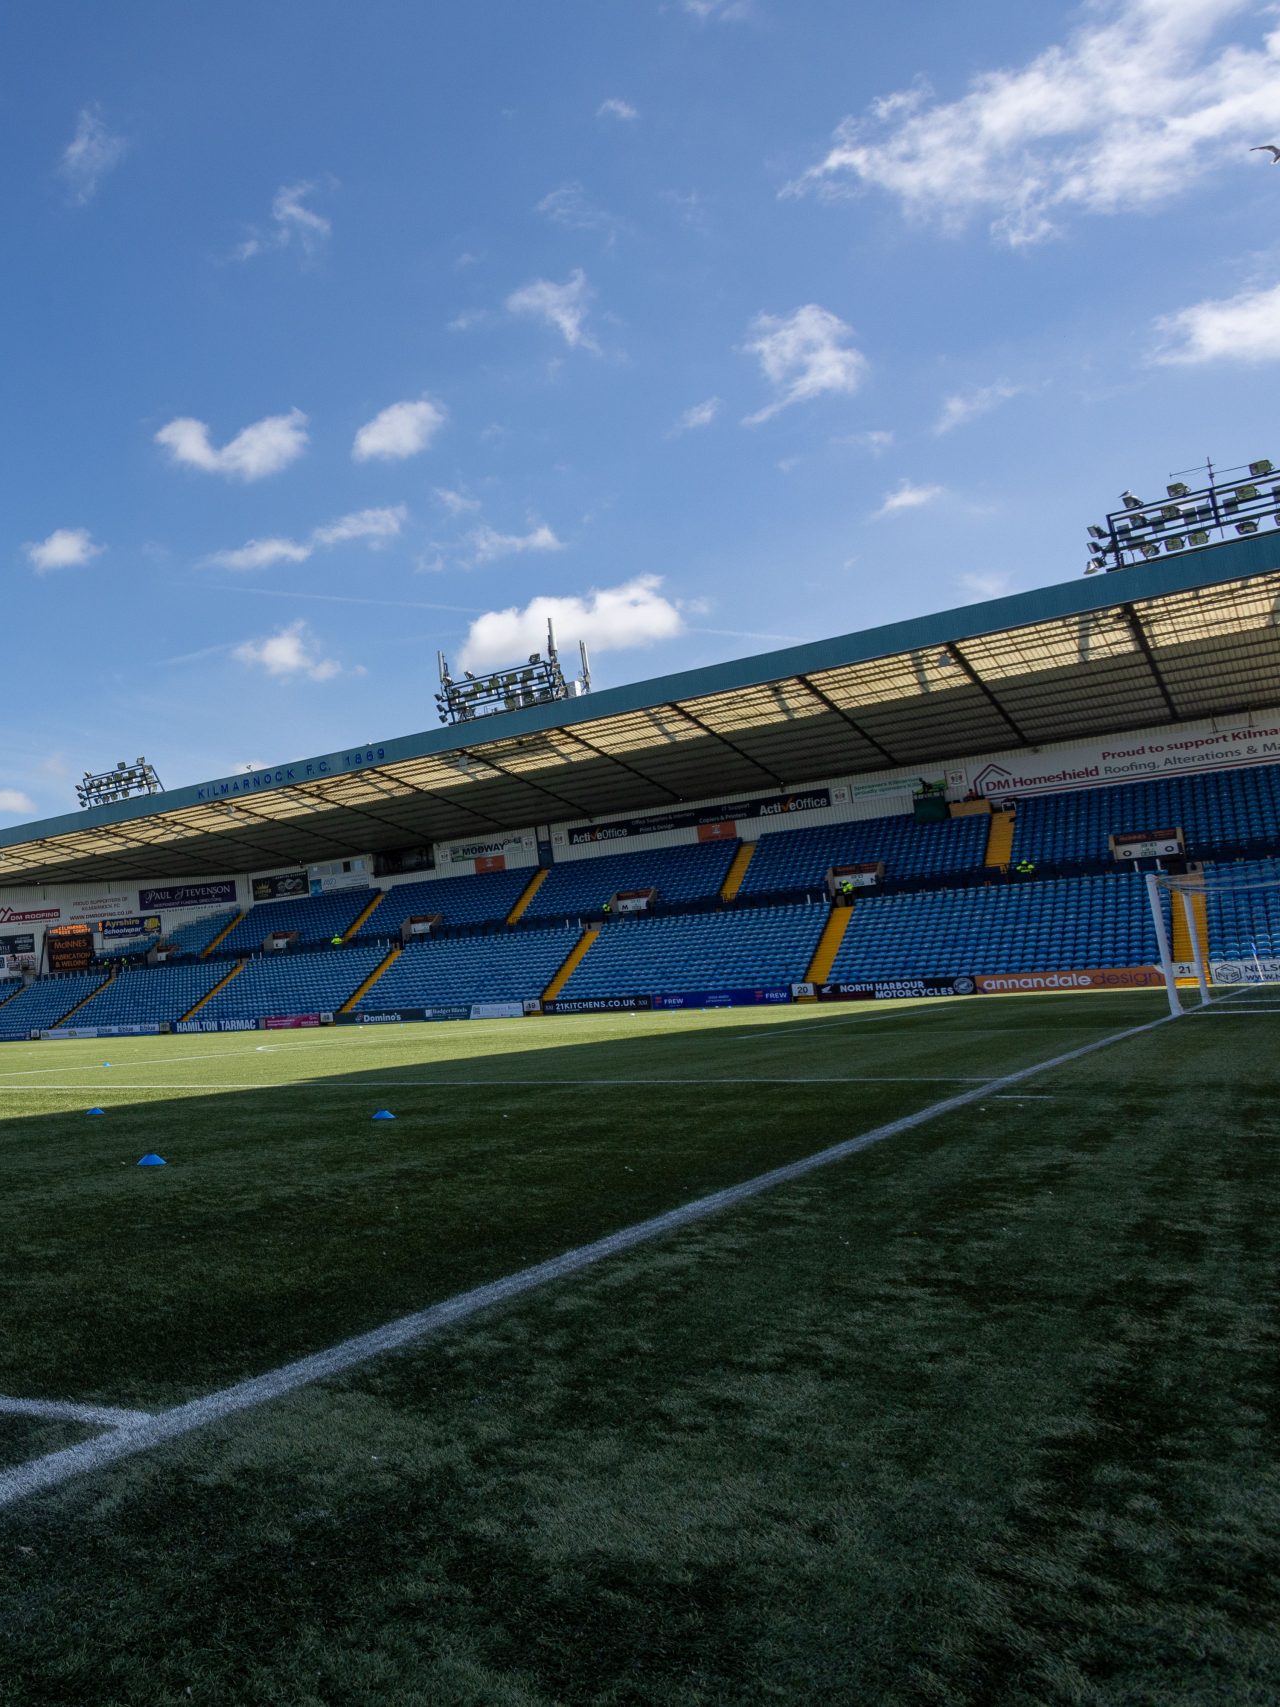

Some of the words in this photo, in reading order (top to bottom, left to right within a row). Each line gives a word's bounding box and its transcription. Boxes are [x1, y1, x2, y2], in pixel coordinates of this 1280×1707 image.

[1102, 746, 1145, 760] Proud
[1148, 744, 1164, 754] to
[1167, 734, 1228, 751] support
[1231, 727, 1280, 741] Kilma
[985, 780, 1010, 791] DM
[1012, 766, 1099, 787] Homeshield
[1104, 760, 1160, 774] Roofing,
[1163, 748, 1241, 766] Alterations
[1246, 745, 1258, 754] &
[198, 768, 295, 799] KILMARNOCK
[306, 761, 331, 776] F.C.
[345, 748, 385, 766] 1869
[145, 889, 171, 900] PAUL
[175, 885, 231, 899] STEVENSON
[24, 911, 60, 920] ROOFING
[105, 918, 140, 928] Ayrshire
[104, 926, 141, 935] Schoolwear
[53, 940, 87, 950] McINNES
[53, 952, 90, 961] FABRICATION
[1178, 966, 1191, 974] 21
[1244, 963, 1280, 972] NELS
[797, 986, 808, 994] 20
[840, 983, 873, 992] NORTH
[875, 980, 924, 990] HARBOUR
[875, 986, 954, 999] MOTORCYCLES
[555, 999, 636, 1010] 21KITCHENS.CO.UK
[363, 1012, 401, 1022] Domino's
[176, 1020, 218, 1033] HAMILTON
[220, 1019, 256, 1031] TARMAC
